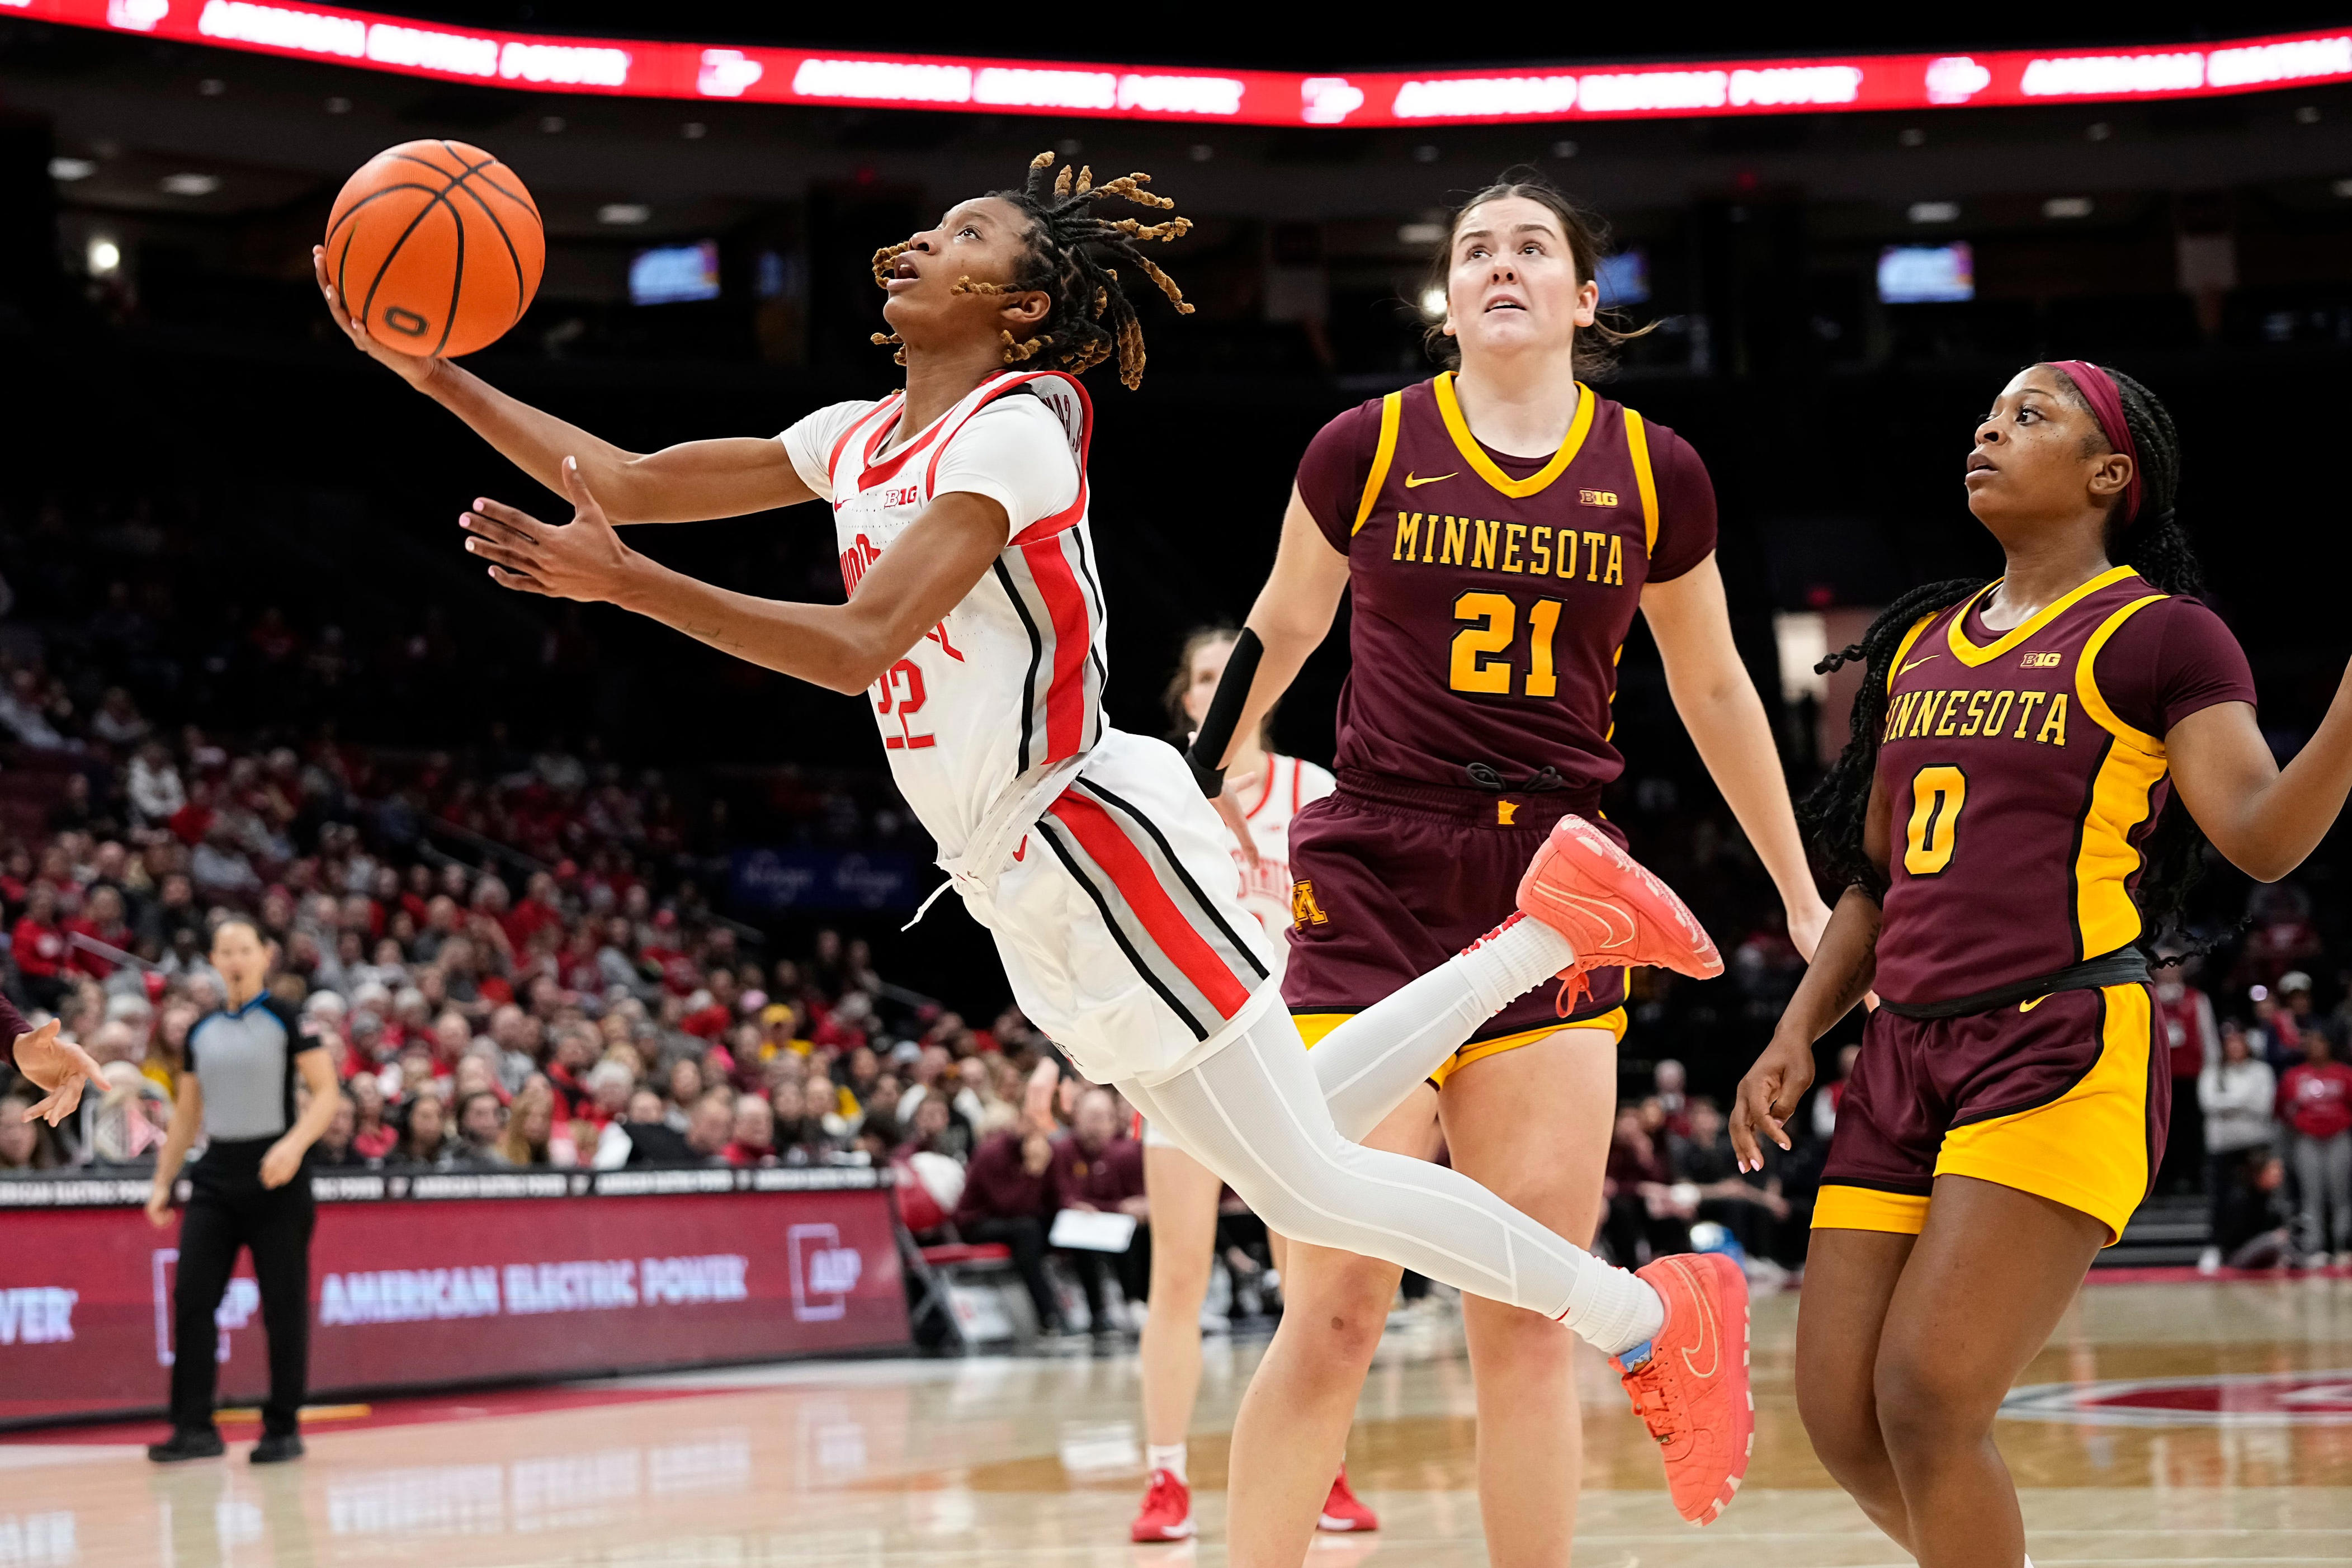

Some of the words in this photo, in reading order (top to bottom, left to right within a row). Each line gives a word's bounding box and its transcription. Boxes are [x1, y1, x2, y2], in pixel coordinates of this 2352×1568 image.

[1393, 511, 1623, 586] MINNESOTA
[1449, 591, 1564, 698] 21
[1883, 689, 2068, 747] INNESOTA
[1904, 764, 1967, 876] 0
[320, 1265, 499, 1325] AMERICAN
[504, 1260, 637, 1315] ELECTRIC
[641, 1254, 748, 1306] POWER
